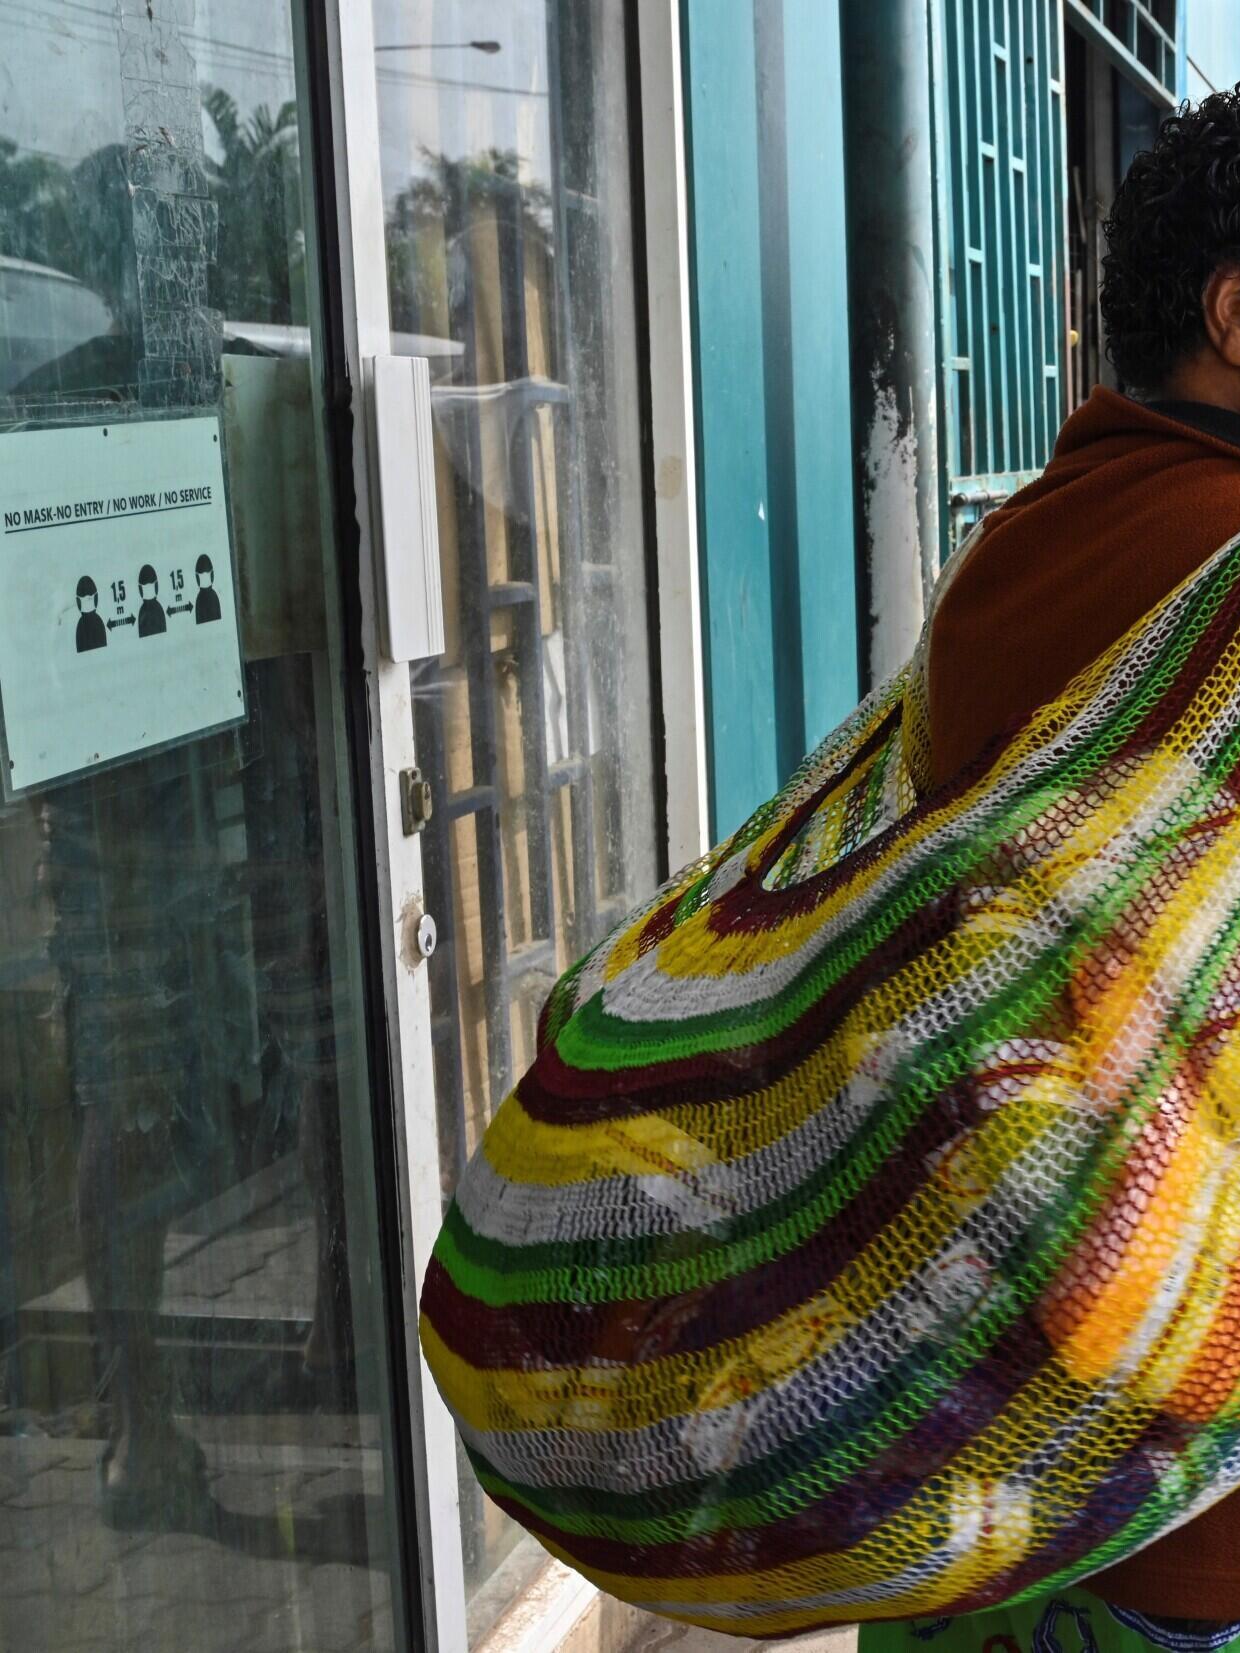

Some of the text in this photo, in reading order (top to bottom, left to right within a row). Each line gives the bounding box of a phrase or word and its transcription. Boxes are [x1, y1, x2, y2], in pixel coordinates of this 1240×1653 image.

[4, 512, 21, 527] NO
[24, 504, 72, 525] MASK-NO
[74, 500, 104, 518] ENTRY
[113, 497, 127, 512] NO
[128, 493, 157, 510] WORK
[164, 491, 178, 505] NO
[179, 486, 212, 503] SERVICE
[175, 593, 183, 602] m
[116, 606, 124, 615] m
